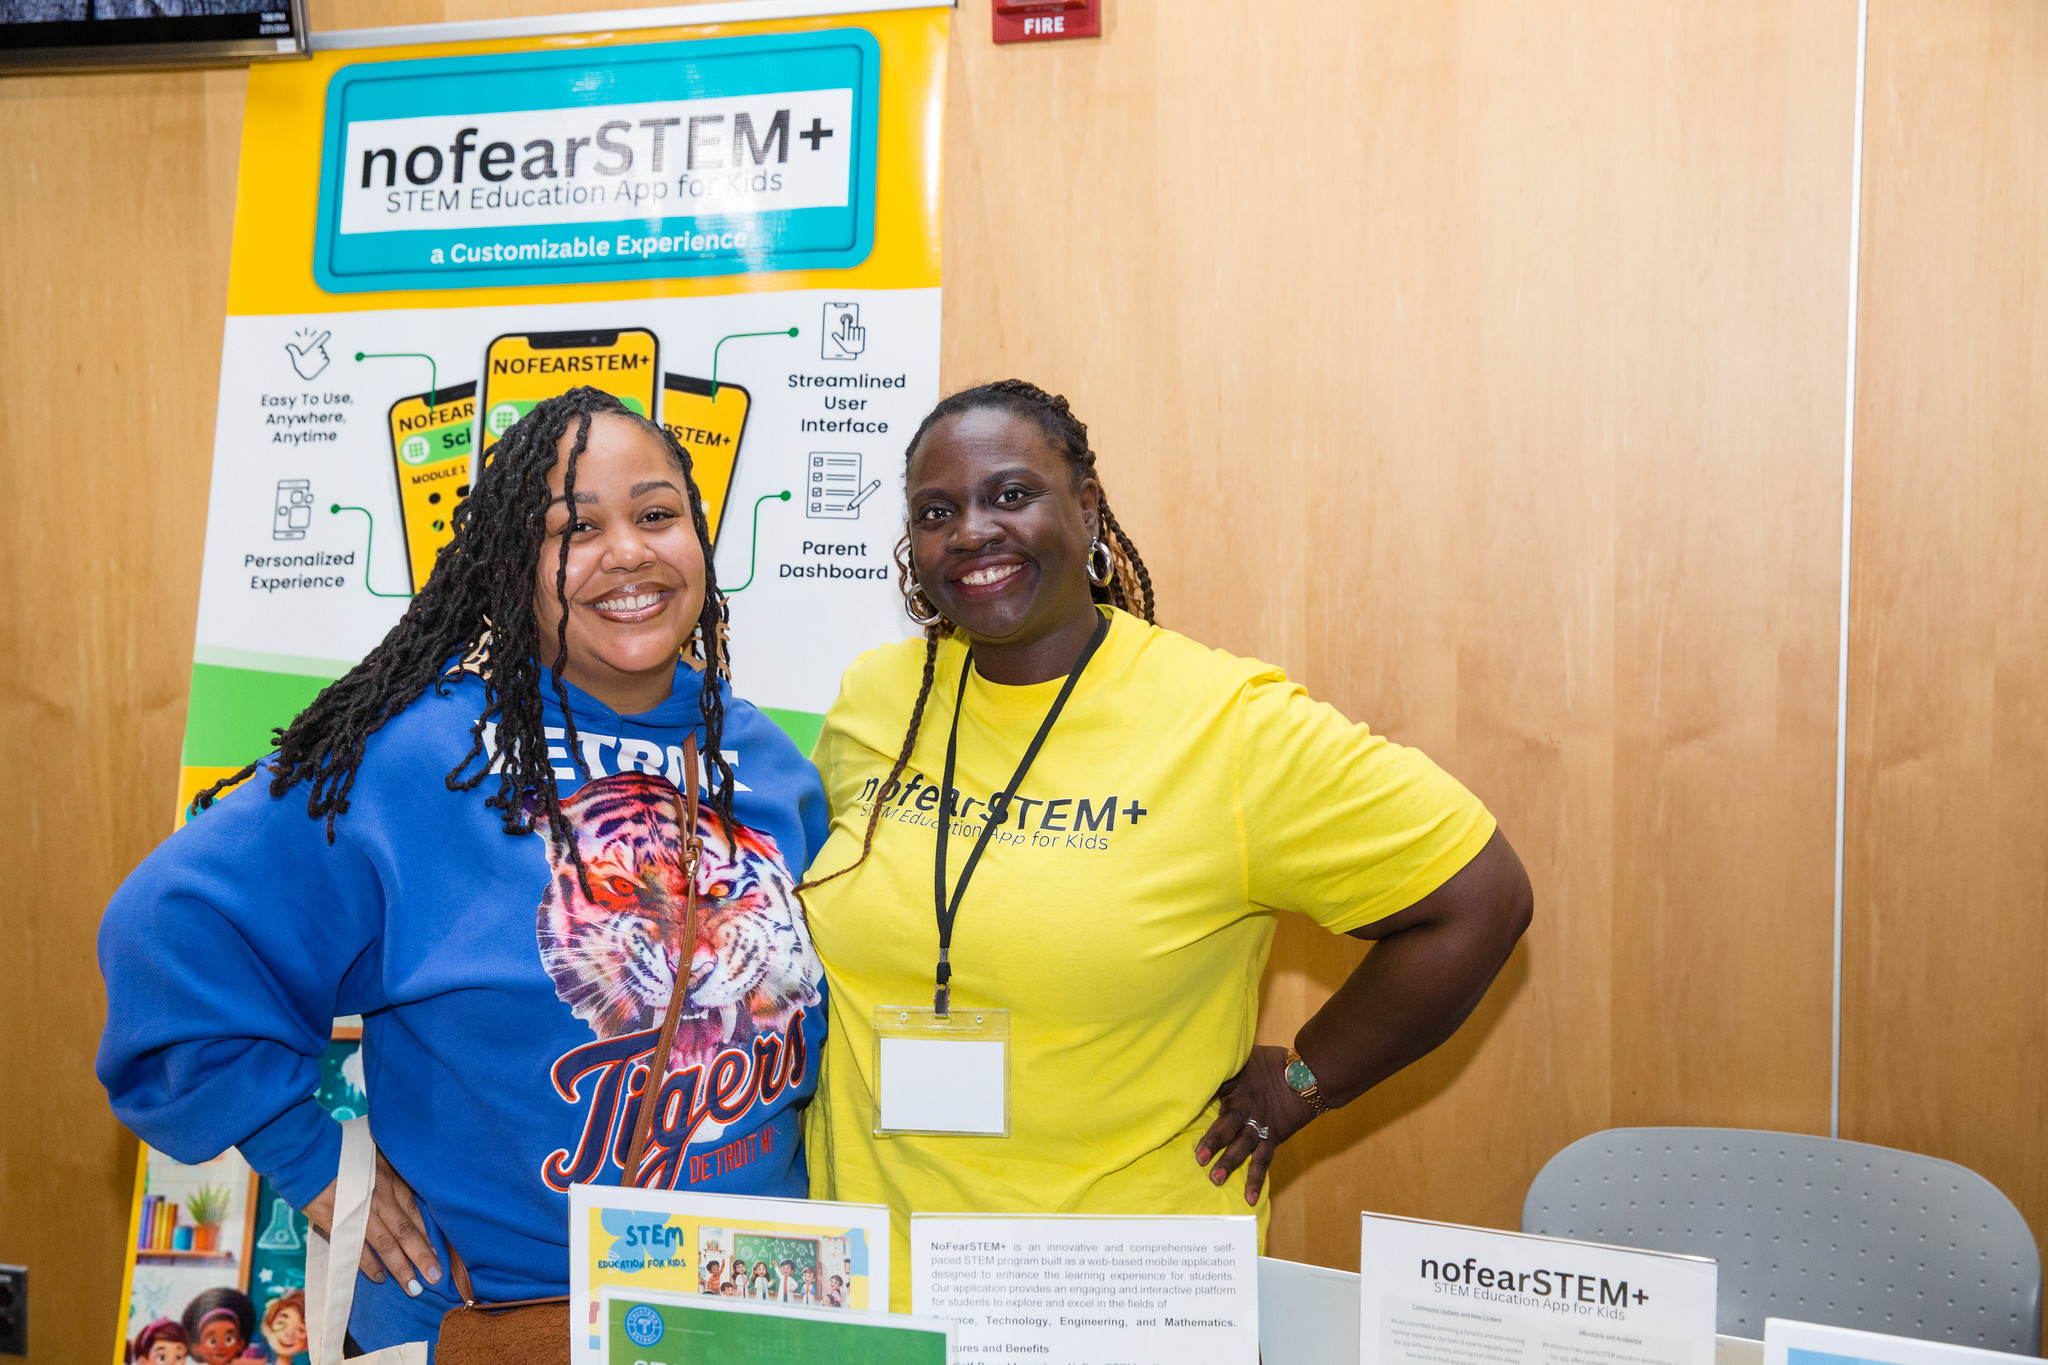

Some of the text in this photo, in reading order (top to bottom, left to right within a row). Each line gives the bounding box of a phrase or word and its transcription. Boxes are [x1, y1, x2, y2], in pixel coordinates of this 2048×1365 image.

[1024, 16, 1065, 35] FIRE
[362, 110, 833, 188] nofearSTEM+
[387, 169, 782, 213] STEM Education App for Kids
[431, 231, 747, 264] a Customizable Experience
[493, 353, 650, 375] NOFEARSTEM+
[788, 374, 905, 389] Streamlined
[261, 392, 354, 409] Easy To Use,
[824, 396, 867, 410] User
[265, 411, 346, 428] Anywhere,
[801, 418, 889, 434] Interface
[272, 429, 337, 447] Anytime
[412, 465, 466, 484] MODULE 1
[802, 541, 867, 556] Parent
[244, 551, 355, 568] Personalized
[780, 564, 888, 580] Dashboard
[251, 573, 345, 593] Experience
[860, 803, 899, 819] STM
[899, 809, 982, 838] Eduction
[1031, 831, 1060, 848] for
[1065, 831, 1109, 851] Kids
[541, 1009, 807, 1193] Tigers
[690, 1125, 776, 1184] DETROIT MI
[626, 1224, 684, 1247] STEM
[931, 1242, 1006, 1251] NoFearSTEM+
[1013, 1242, 1022, 1251] is
[1047, 1242, 1098, 1252] innovative
[1104, 1243, 1124, 1252] and
[1130, 1243, 1207, 1255] comprehensive
[1214, 1243, 1235, 1253] self-
[598, 1258, 686, 1269] EDUCATION FOR KIDS
[931, 1256, 1236, 1268] paced STEM program built as a web-based mobile application
[931, 1269, 1236, 1282] designed to enhance the learning experience for students.
[1421, 1258, 1649, 1308] nofearSTEM+
[932, 1283, 1236, 1296] Our application provides an engaging and interactive platform
[932, 1296, 1168, 1309] for students to explore and excel in the fields of
[1434, 1281, 1625, 1321] STEM Education App for Kids
[1412, 1302, 1502, 1323] Continuous Updates and New Content
[986, 1316, 1052, 1328] Technology,
[1060, 1317, 1128, 1328] Engineering,
[1136, 1318, 1156, 1327] and
[1165, 1317, 1237, 1327] Mathematics.
[982, 1343, 1002, 1353] and
[1005, 1344, 1050, 1353] Benefits
